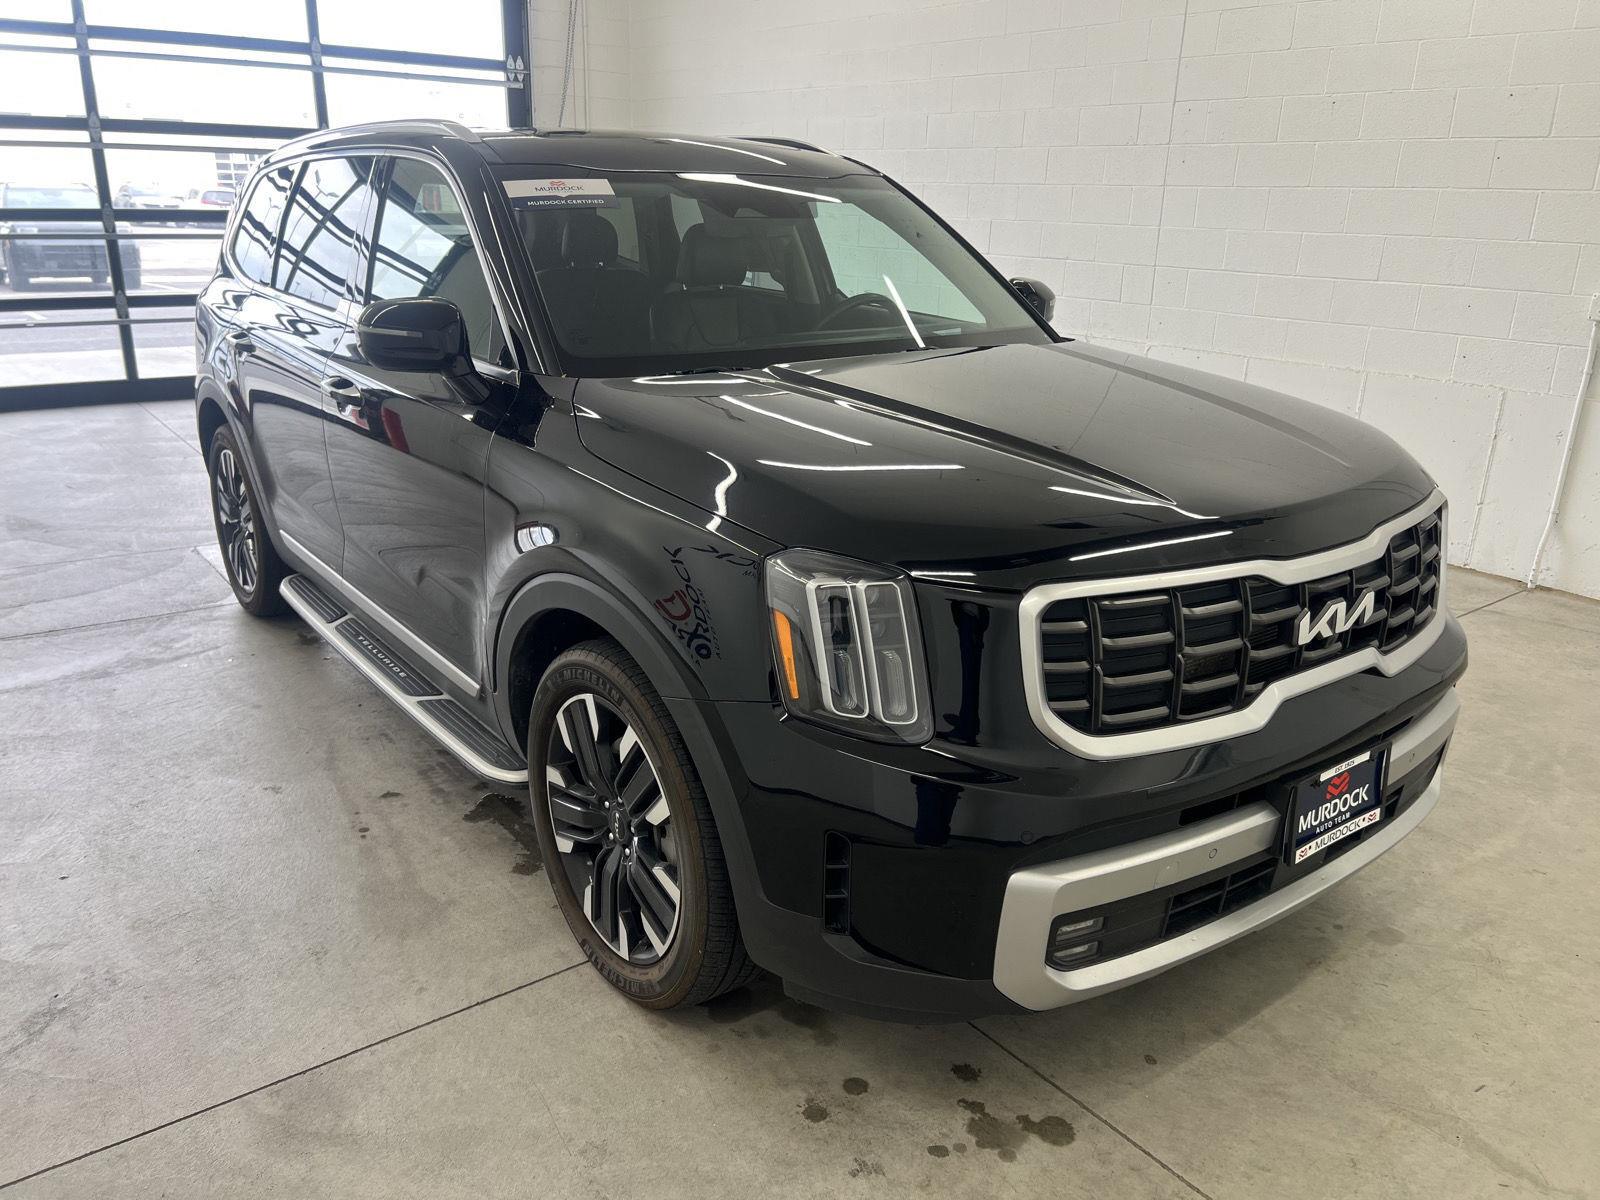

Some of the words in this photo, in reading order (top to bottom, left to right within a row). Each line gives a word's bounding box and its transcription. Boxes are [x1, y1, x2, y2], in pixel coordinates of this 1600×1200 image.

[1296, 590, 1375, 646] KIA
[357, 636, 407, 678] TELLURIDE
[563, 668, 621, 702] MICHELIN
[1298, 784, 1370, 833] MURDOCK
[1315, 821, 1333, 834] AUTO
[1334, 811, 1351, 825] TEAM
[1314, 819, 1361, 851] MURDOCK
[583, 943, 640, 994] MICHELIN
